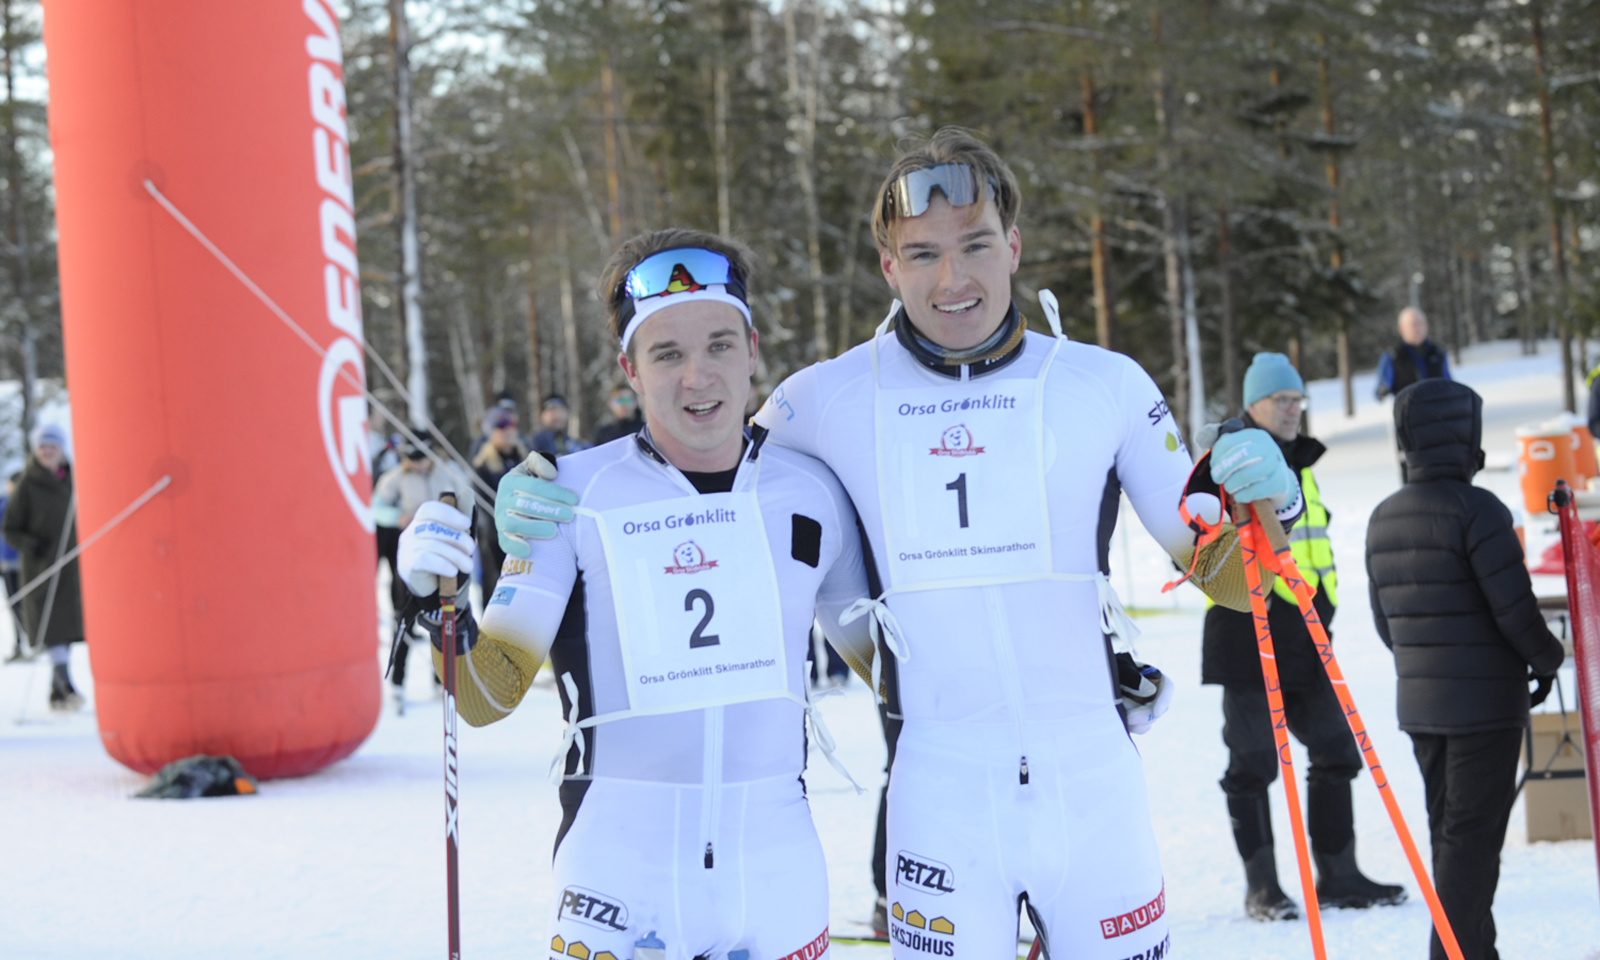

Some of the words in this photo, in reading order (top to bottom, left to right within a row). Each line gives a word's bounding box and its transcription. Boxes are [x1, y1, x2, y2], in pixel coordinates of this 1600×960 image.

[898, 403, 936, 416] Orsa
[945, 472, 970, 529] 1
[623, 520, 661, 535] Orsa
[899, 552, 923, 562] Orsa
[925, 547, 968, 559] Grönklitt
[970, 541, 1036, 556] Skimarathon
[684, 588, 721, 650] 2
[640, 674, 664, 684] Orsa
[667, 665, 713, 681] Grönklitt
[715, 658, 776, 674] Skimarathon
[895, 854, 956, 893] PETZL
[558, 889, 629, 931] PETZL
[891, 922, 955, 957] EKSJÖHUS
